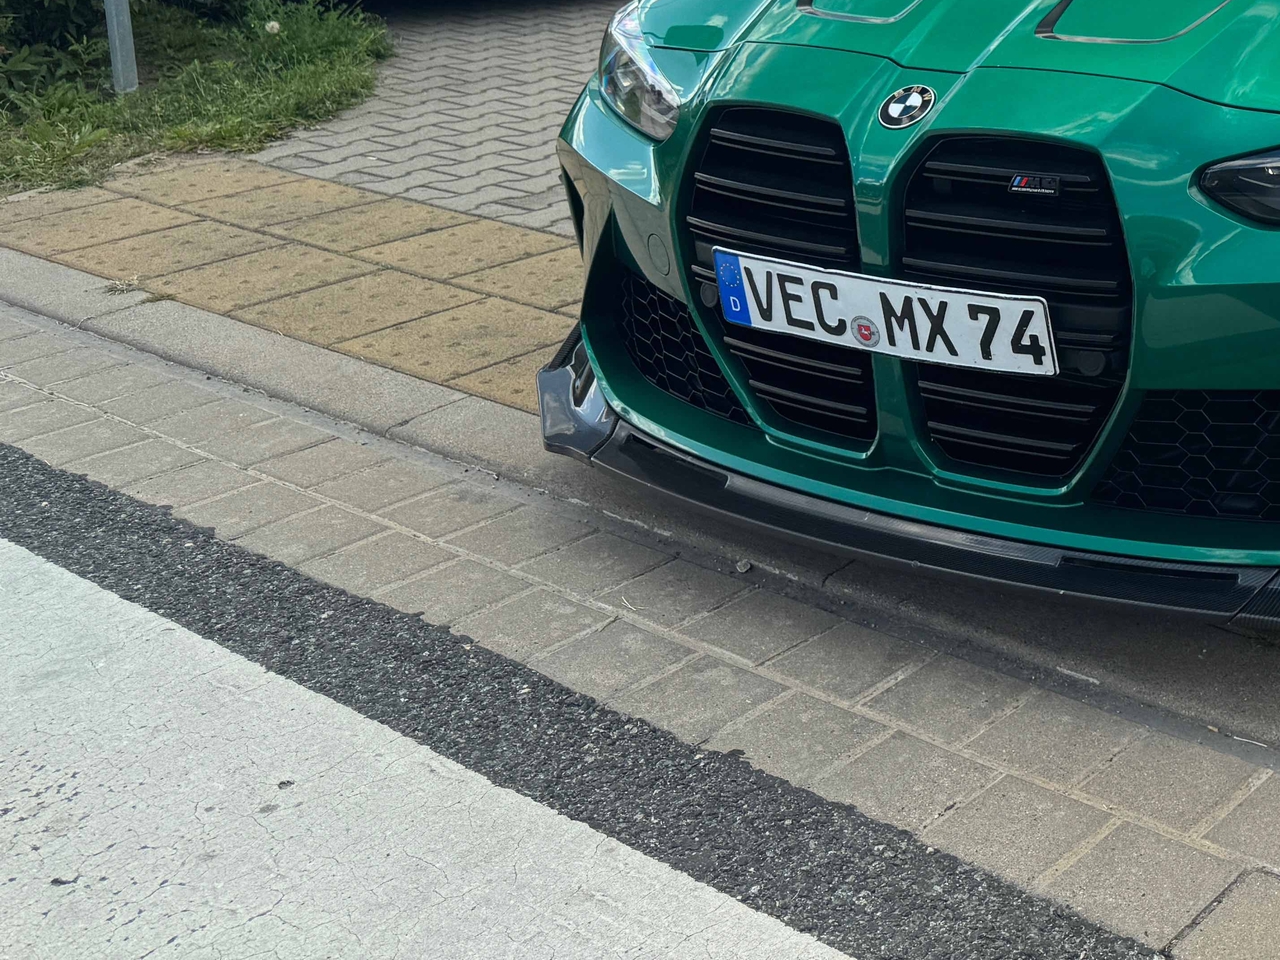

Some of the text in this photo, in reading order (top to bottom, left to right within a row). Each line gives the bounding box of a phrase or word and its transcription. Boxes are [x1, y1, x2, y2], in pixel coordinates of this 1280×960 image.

[893, 86, 933, 101] BMW
[730, 296, 741, 312] D
[744, 266, 847, 337] VEC
[879, 291, 959, 357] MX
[967, 303, 1047, 366] 74
